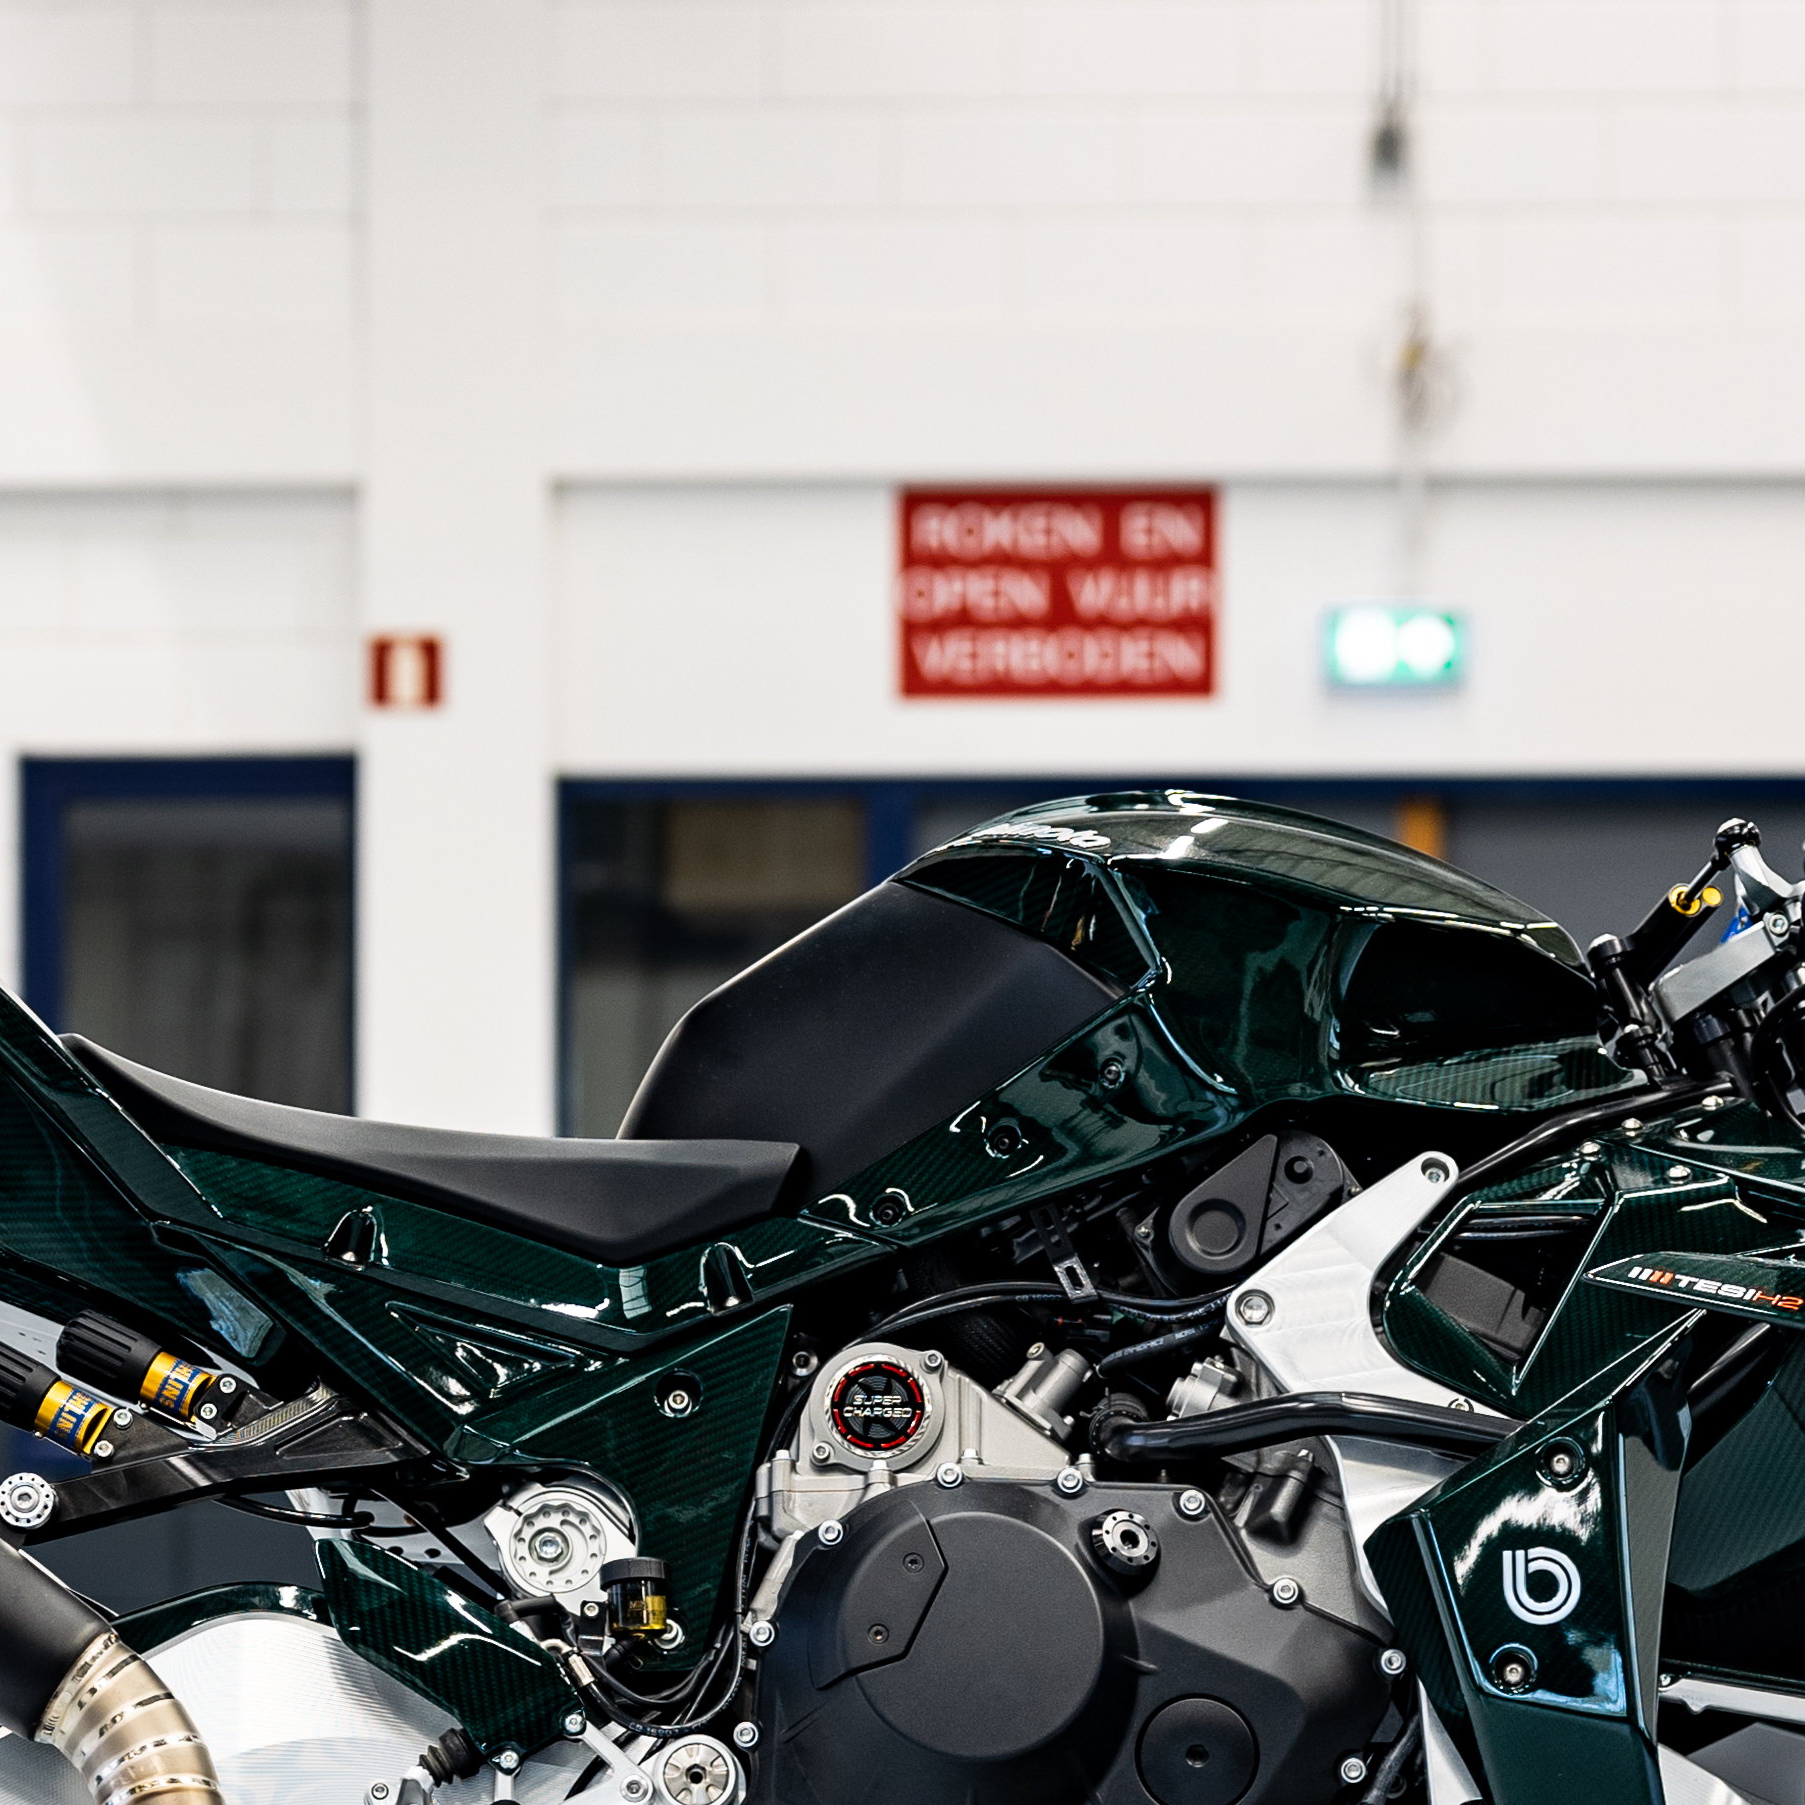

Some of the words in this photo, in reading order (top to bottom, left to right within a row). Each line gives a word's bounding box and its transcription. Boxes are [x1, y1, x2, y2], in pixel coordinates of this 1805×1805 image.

[1120, 503, 1202, 557] EN
[158, 1361, 195, 1409] HLINS
[853, 1395, 902, 1405] SUPER
[843, 1406, 913, 1418] CHARGED
